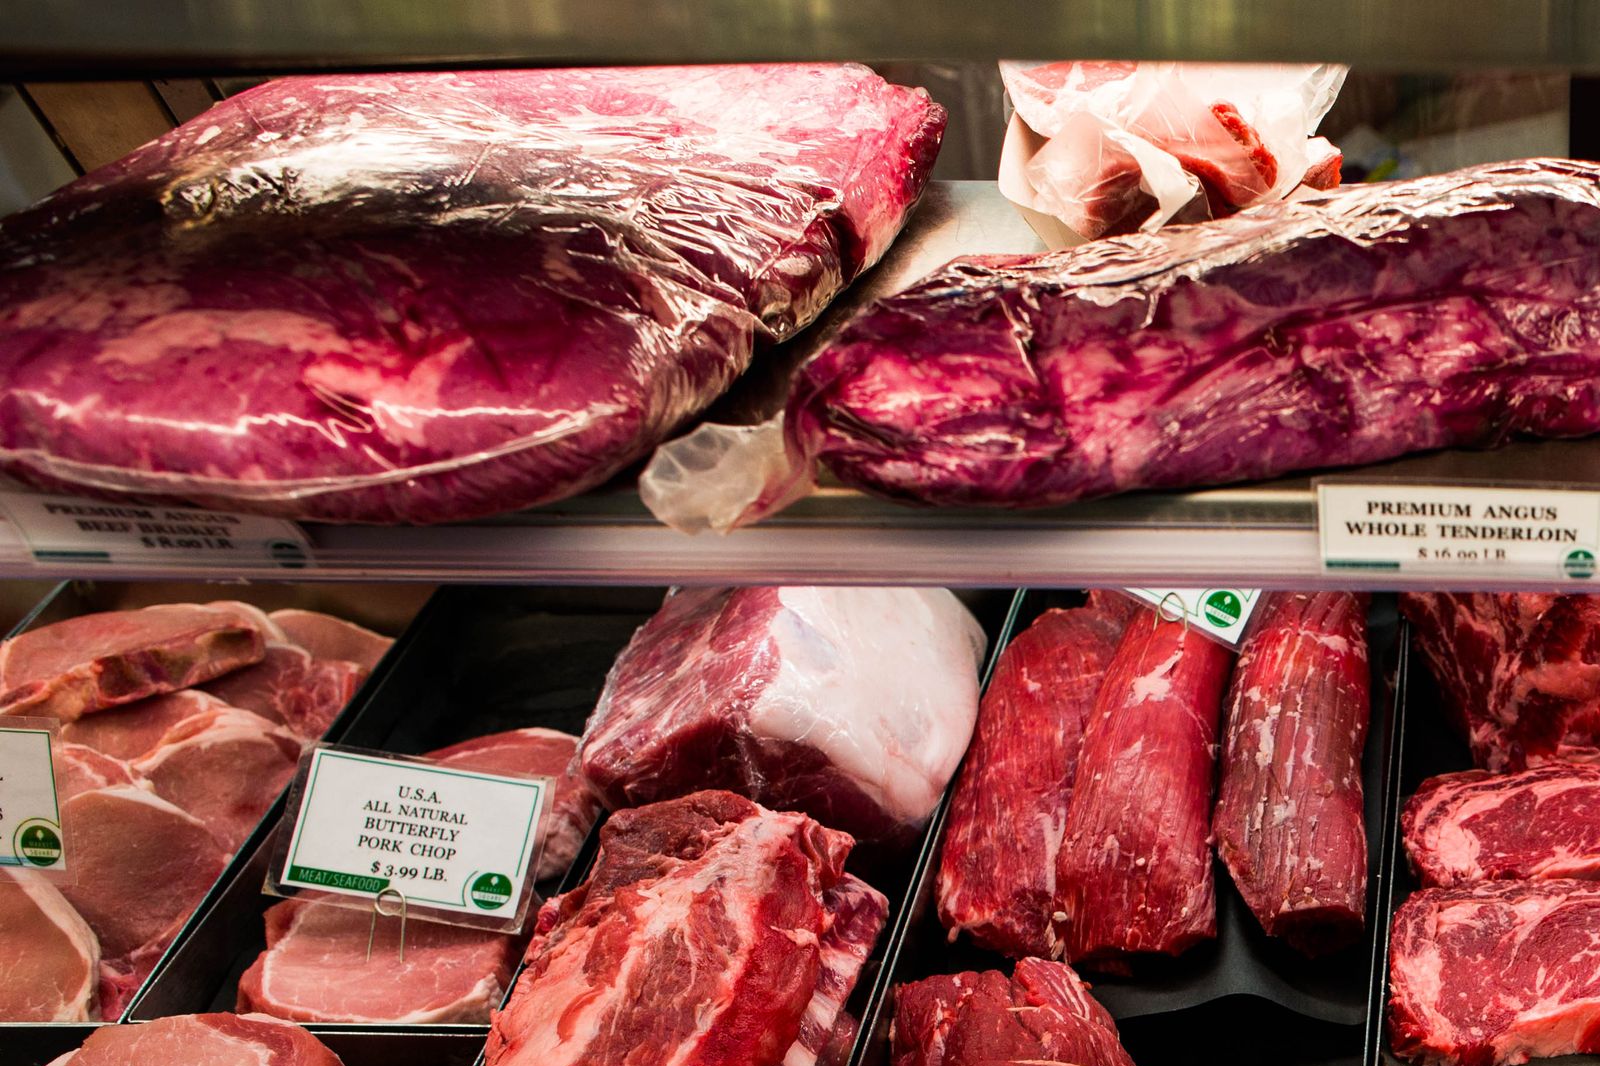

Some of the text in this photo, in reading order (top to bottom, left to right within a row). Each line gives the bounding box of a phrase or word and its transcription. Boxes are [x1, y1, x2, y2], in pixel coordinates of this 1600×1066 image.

[1367, 501, 1558, 521] PREMIUM ANGUS
[75, 519, 231, 537] BEEF BRISKET
[1346, 521, 1578, 543] WHOLE TENDERLOIN
[398, 785, 442, 804] U.S.A.
[363, 800, 469, 826] ALL NATURAL
[364, 816, 460, 843] BUTTERFLY
[357, 834, 456, 861] PORK CHOP
[299, 868, 380, 892] MEAT/SEAFOOD
[370, 861, 448, 882] $ 3.99 LB.
